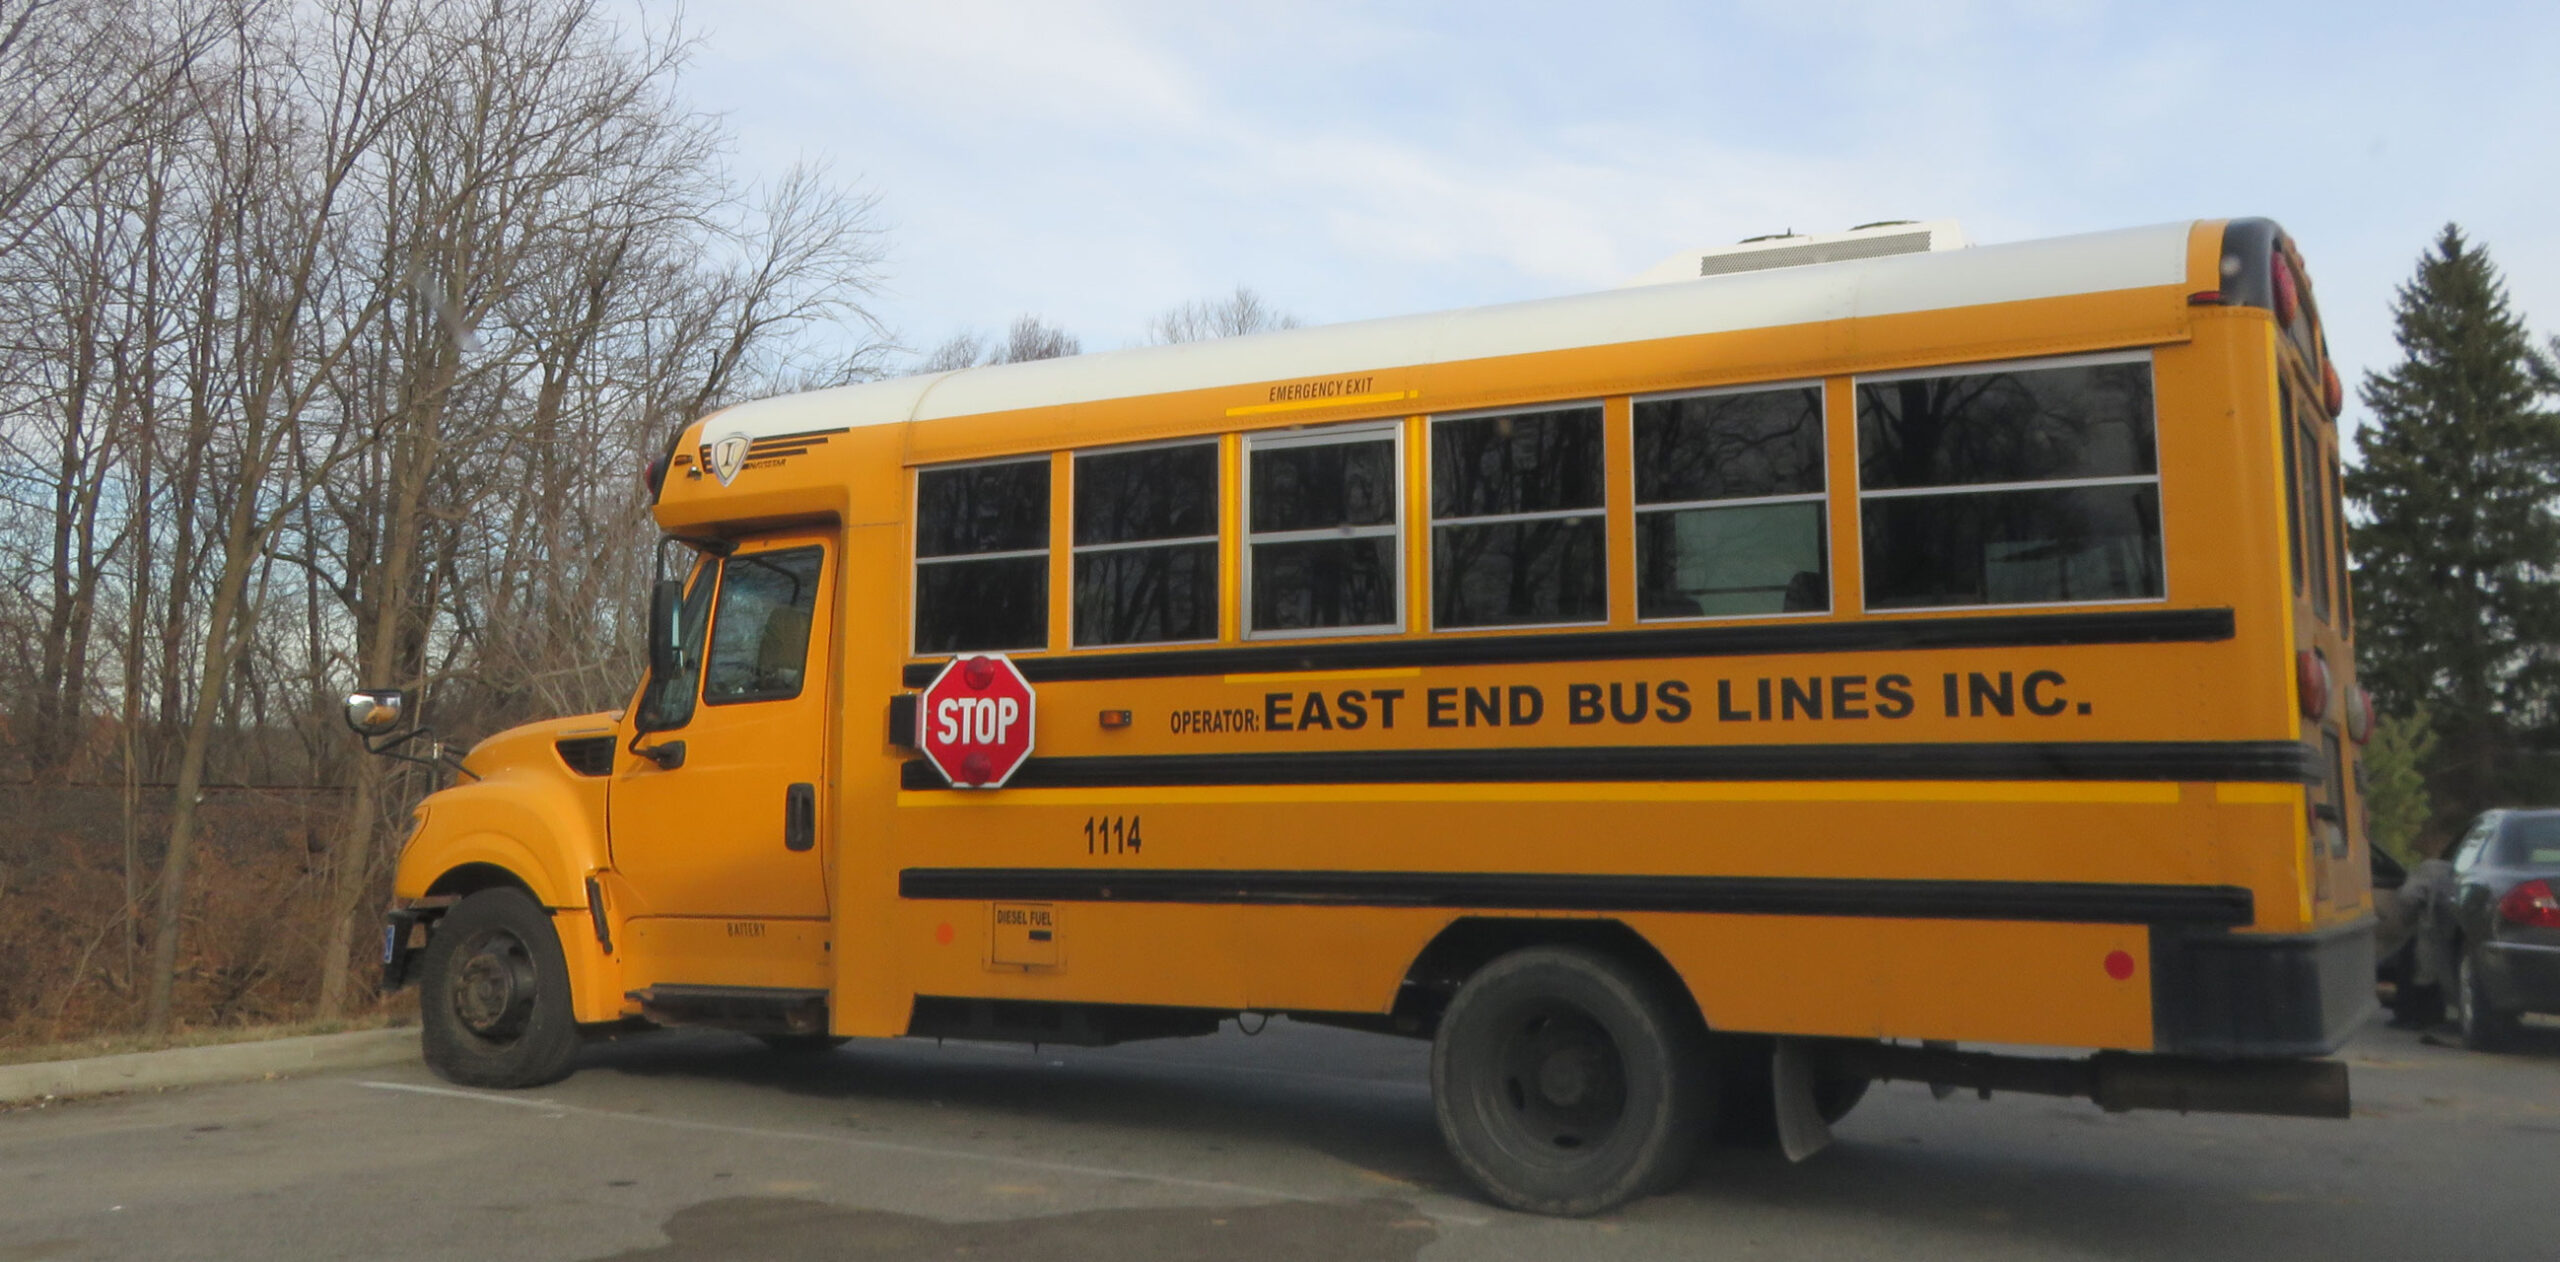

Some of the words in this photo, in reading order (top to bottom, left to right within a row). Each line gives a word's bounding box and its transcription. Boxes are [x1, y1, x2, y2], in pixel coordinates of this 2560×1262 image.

[1269, 380, 1343, 402] EMERGENCY
[1346, 377, 1373, 394] EXIT
[1170, 708, 1259, 734] OPERATOR:
[1265, 689, 1405, 732] EAST
[1427, 685, 1544, 728] END
[1568, 680, 1692, 725] BUS
[1717, 673, 1915, 722] LINES
[1943, 669, 2092, 718] INC.
[937, 697, 1019, 745] STOP
[1084, 815, 1142, 854] 1114
[727, 922, 767, 937] BATTERY
[997, 909, 1028, 925] DIESEL
[1030, 910, 1052, 927] FUEL
